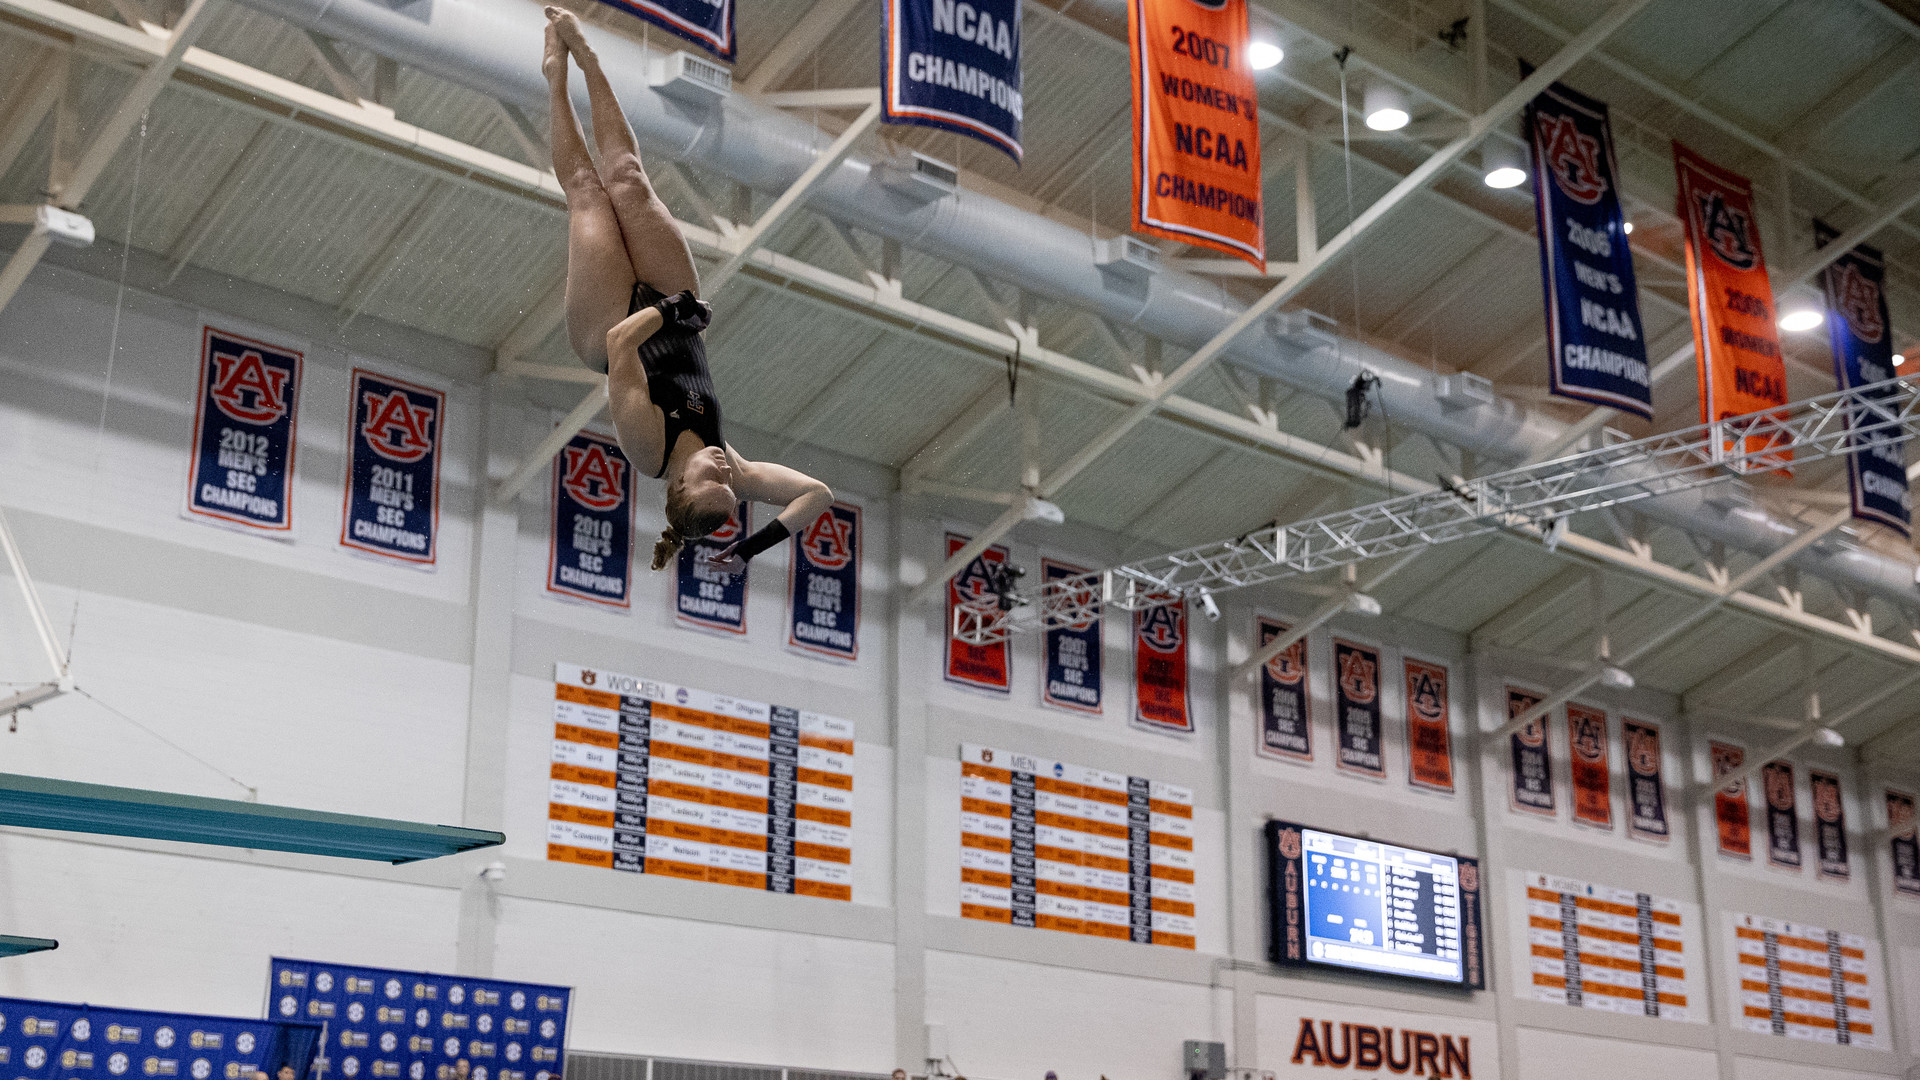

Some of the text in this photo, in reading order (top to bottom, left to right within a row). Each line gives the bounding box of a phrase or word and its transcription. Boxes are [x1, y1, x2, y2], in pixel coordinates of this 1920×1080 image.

[933, 0, 1012, 60] NCAA
[1171, 25, 1230, 69] 2007
[1175, 122, 1248, 171] NCAA
[1581, 296, 1637, 340] NCAA
[220, 427, 269, 457] 2012
[218, 449, 268, 477] MEN'S
[226, 470, 257, 493] SEC
[371, 464, 413, 492] 2011
[202, 483, 278, 519] CHAMPIONS
[370, 485, 414, 512] MEN'S
[377, 506, 405, 527] SEC
[573, 514, 612, 540] 2010
[354, 518, 426, 551] CHAMPIONS
[573, 532, 612, 557] MEN'S
[578, 551, 603, 572] SEC
[560, 565, 623, 594] CHAMPIONS
[699, 581, 723, 601] SEC
[680, 594, 741, 621] CHAMPIONS
[812, 608, 836, 628] SEC
[796, 621, 852, 648] CHAMPIONS
[607, 674, 666, 699] WOMEN
[1011, 755, 1036, 771] MEN
[1285, 860, 1300, 960] AUBURN
[1291, 1017, 1472, 1080] AUBURN
